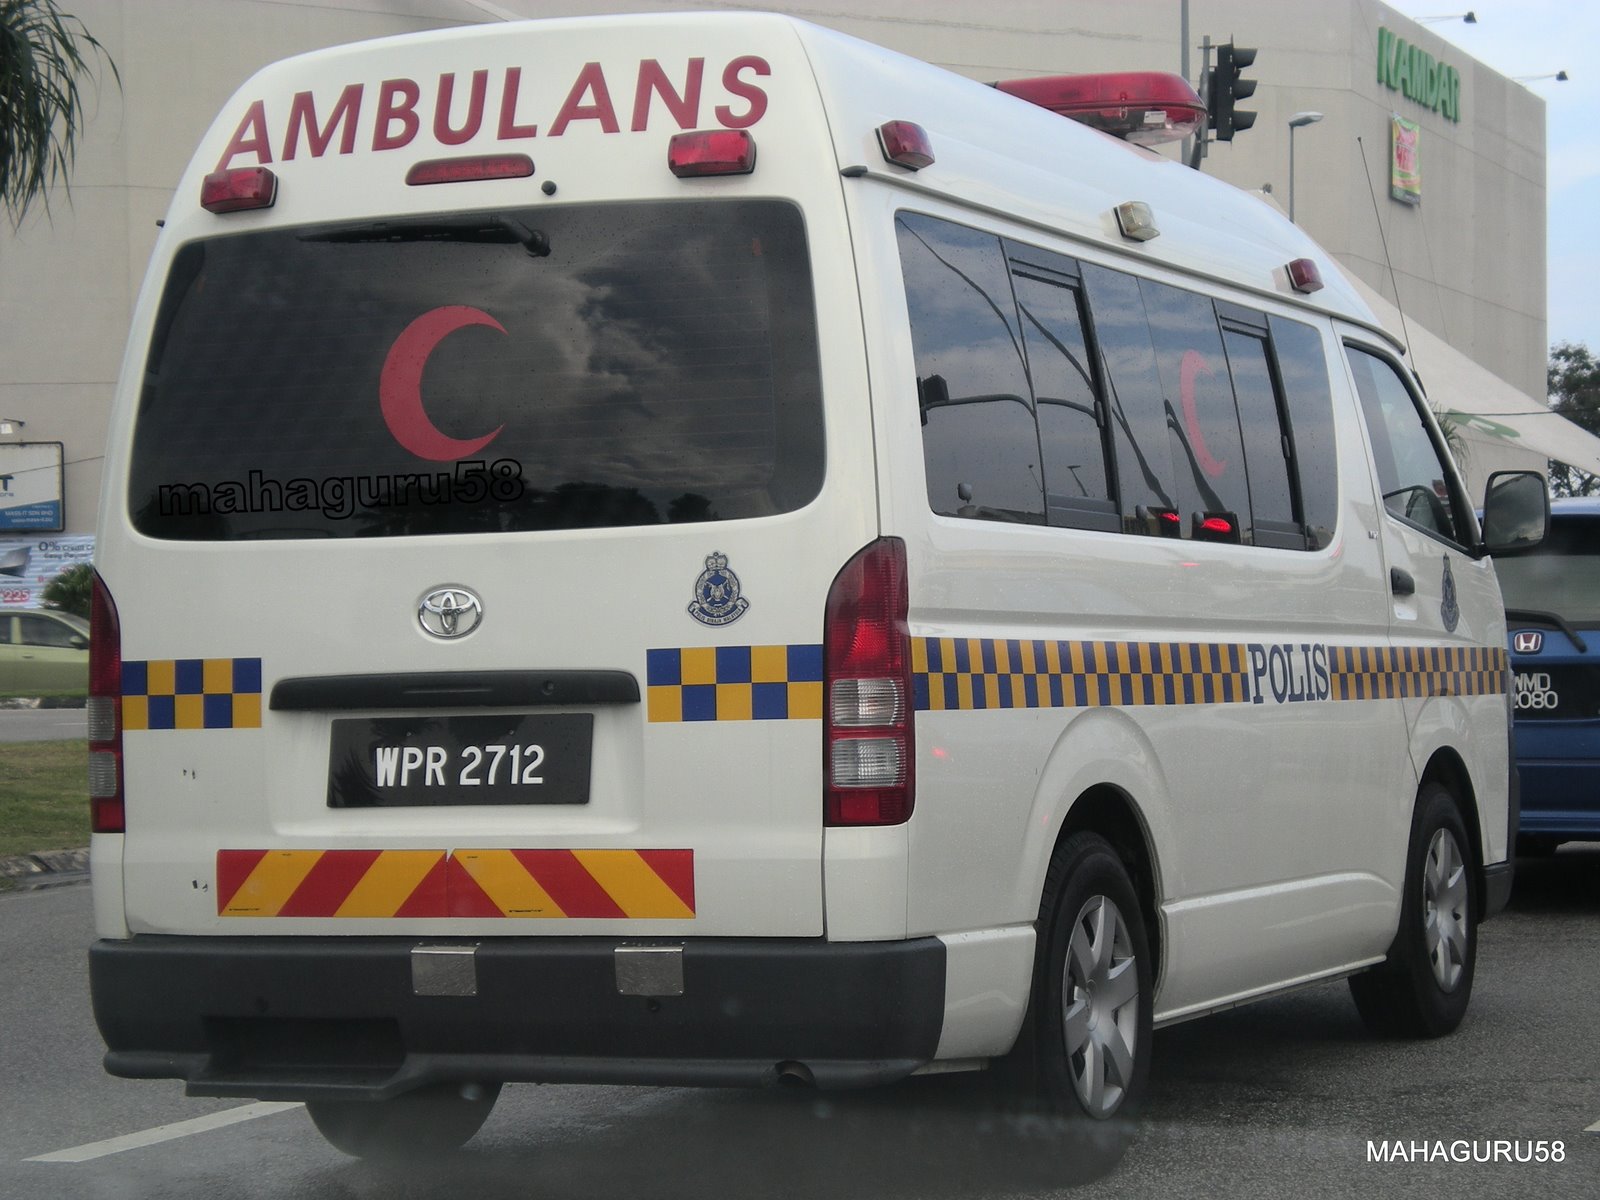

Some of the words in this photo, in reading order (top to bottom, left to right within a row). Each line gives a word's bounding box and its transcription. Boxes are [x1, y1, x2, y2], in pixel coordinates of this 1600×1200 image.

[1377, 26, 1461, 124] KAMDAR
[213, 55, 772, 172] AMBULANS
[39, 541, 61, 551] 0%
[1247, 643, 1329, 704] POLIS
[376, 746, 447, 787] WPR
[459, 744, 545, 786] 2712
